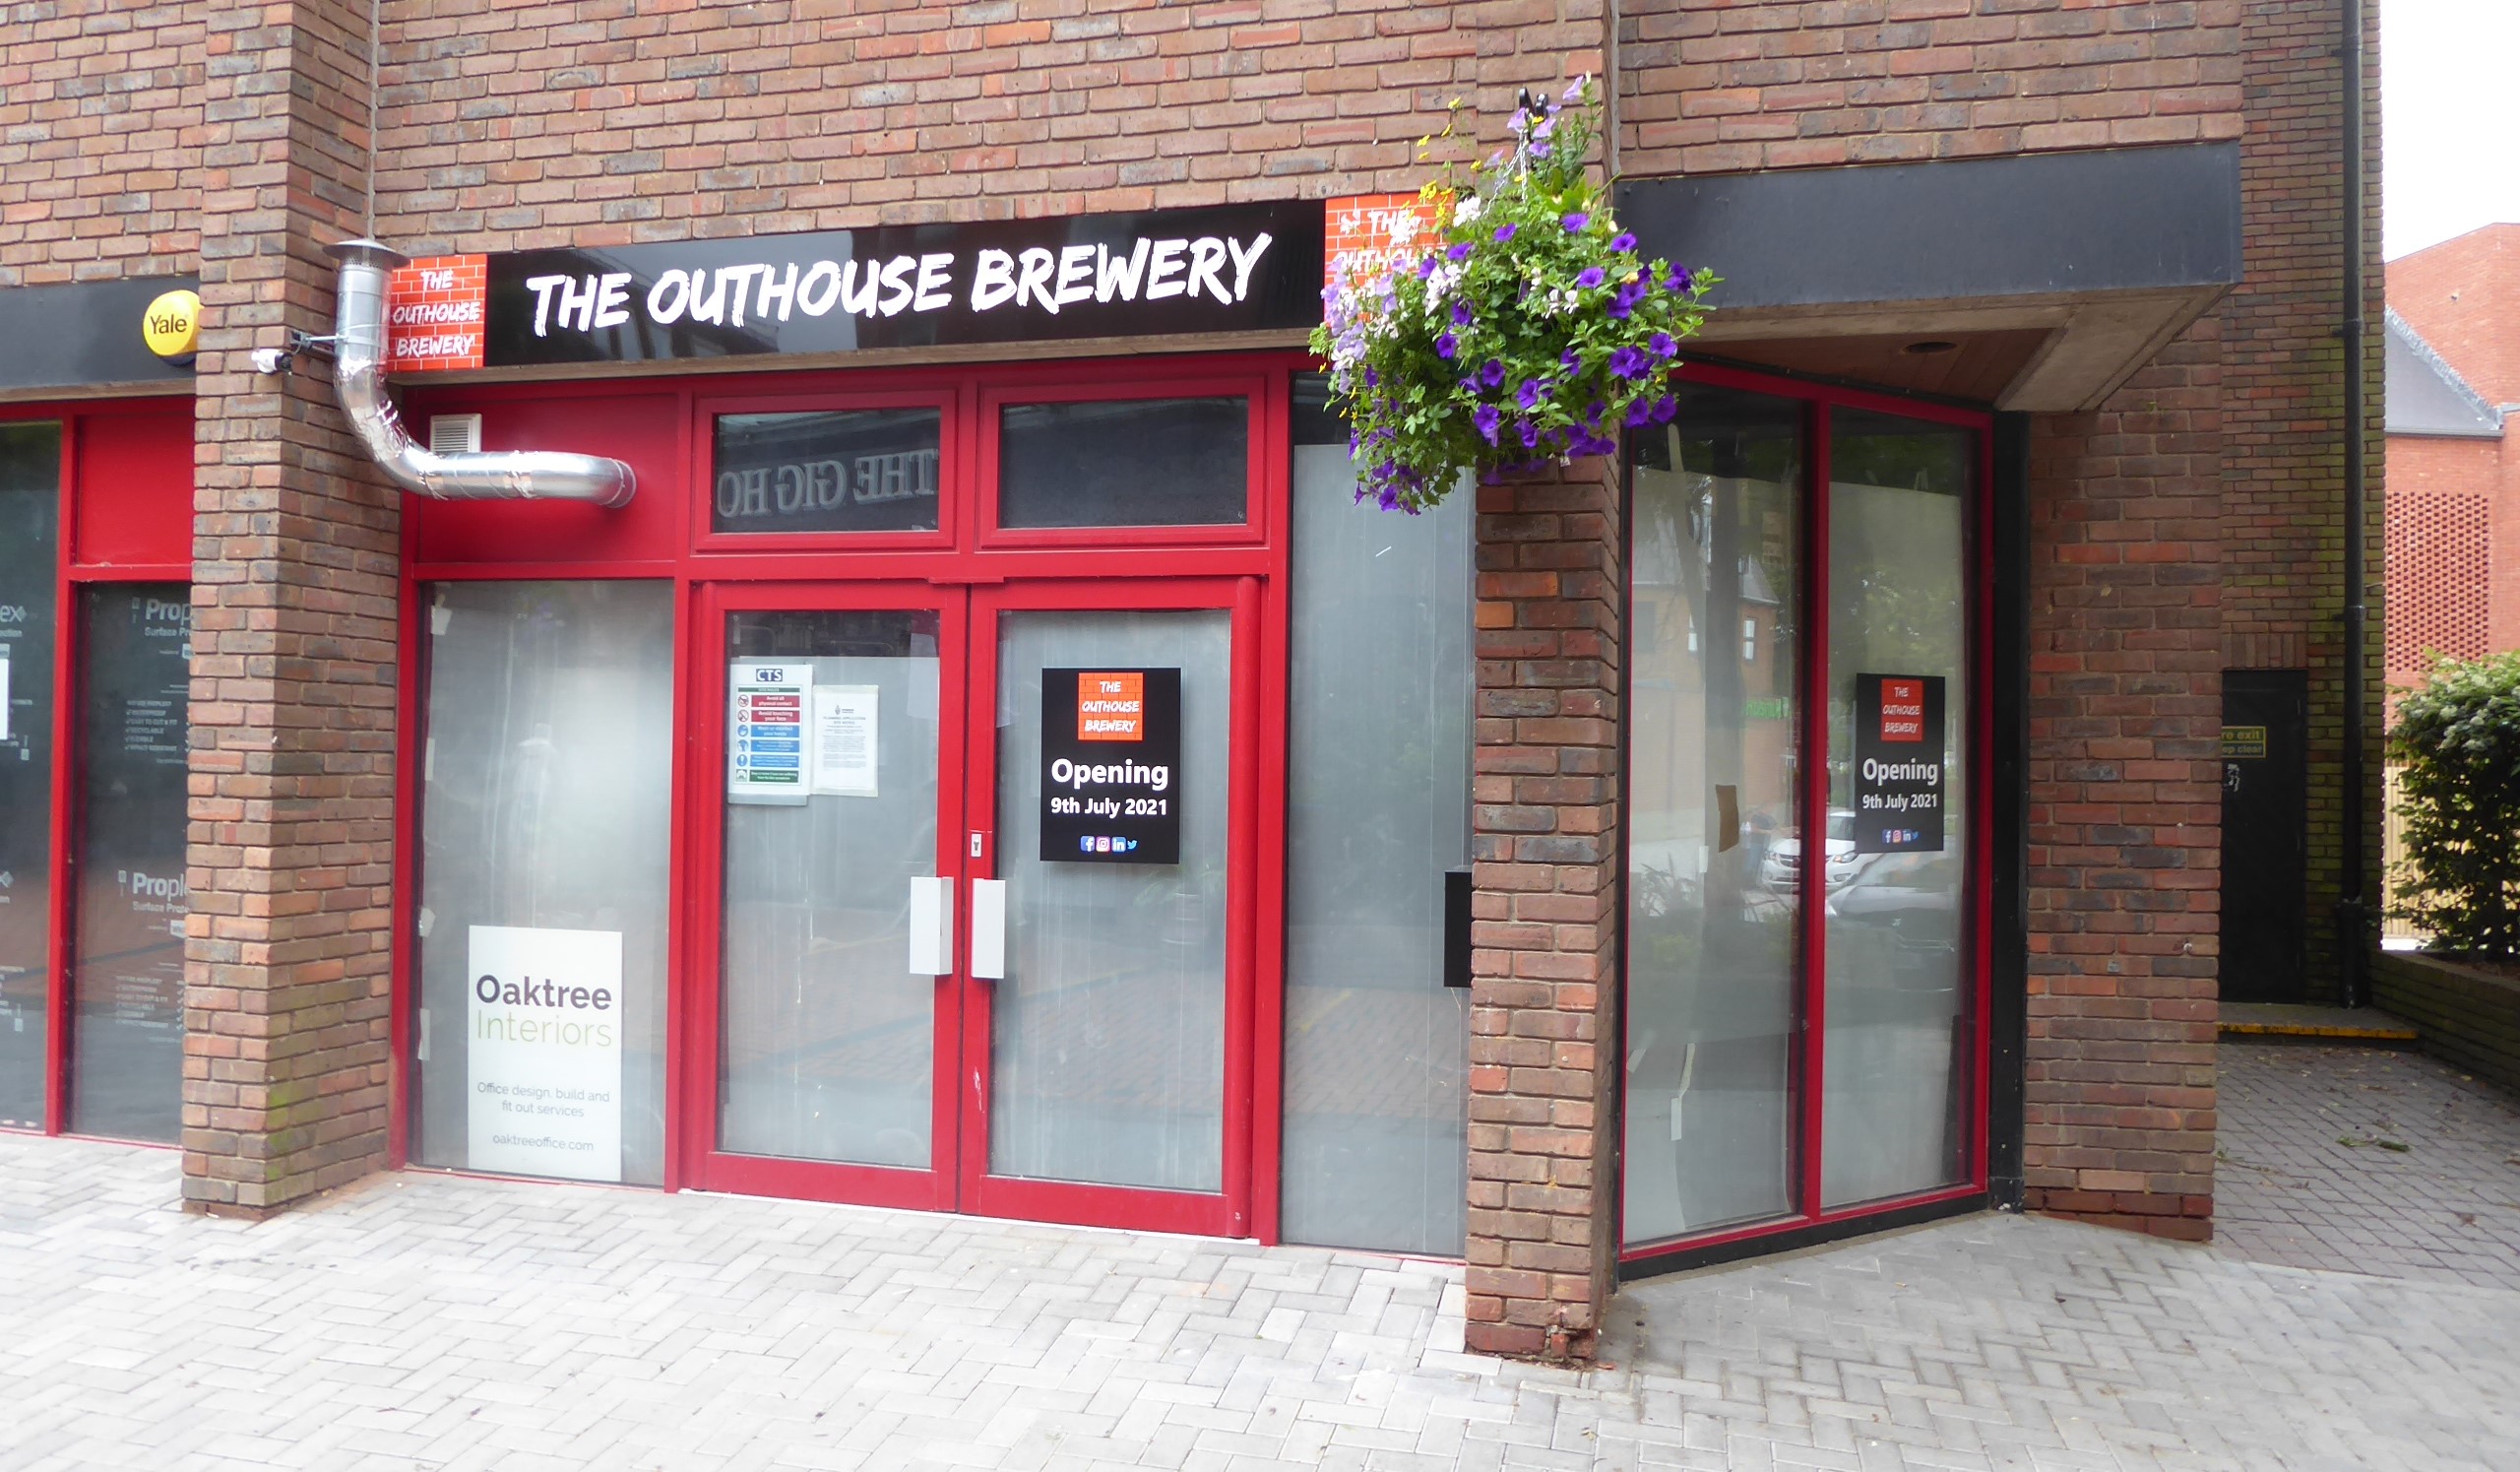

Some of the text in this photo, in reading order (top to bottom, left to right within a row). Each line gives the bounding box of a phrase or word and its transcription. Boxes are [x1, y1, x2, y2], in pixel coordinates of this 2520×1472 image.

[420, 270, 454, 291] THE
[526, 231, 1274, 337] THE OUTHOUSE BREWERY
[394, 301, 480, 324] OUTHOUSE
[150, 313, 188, 335] Yale
[396, 335, 475, 357] BREWERY
[757, 670, 782, 681] CTS
[1100, 680, 1122, 694] THE
[1894, 686, 1910, 698] THE
[1082, 700, 1140, 713] OUTHOUSE
[1882, 704, 1921, 716] OUTHOUSE
[1085, 720, 1137, 733] BREWERY
[1884, 722, 1919, 734] BREWERY
[2236, 730, 2260, 739] exit
[2237, 744, 2262, 754] clear
[1050, 758, 1168, 791] Opening
[1862, 757, 1938, 786] Opening
[1050, 797, 1166, 819] 9th July 2021
[1862, 794, 1937, 812] 9th July 2021
[476, 973, 612, 1011] Oaktree
[476, 1009, 612, 1048] Interiors
[476, 1080, 509, 1095] Office
[555, 1088, 585, 1101] build
[588, 1091, 610, 1103] and
[502, 1099, 585, 1118] fit out services
[492, 1133, 595, 1151] oaktreeoffice.com
